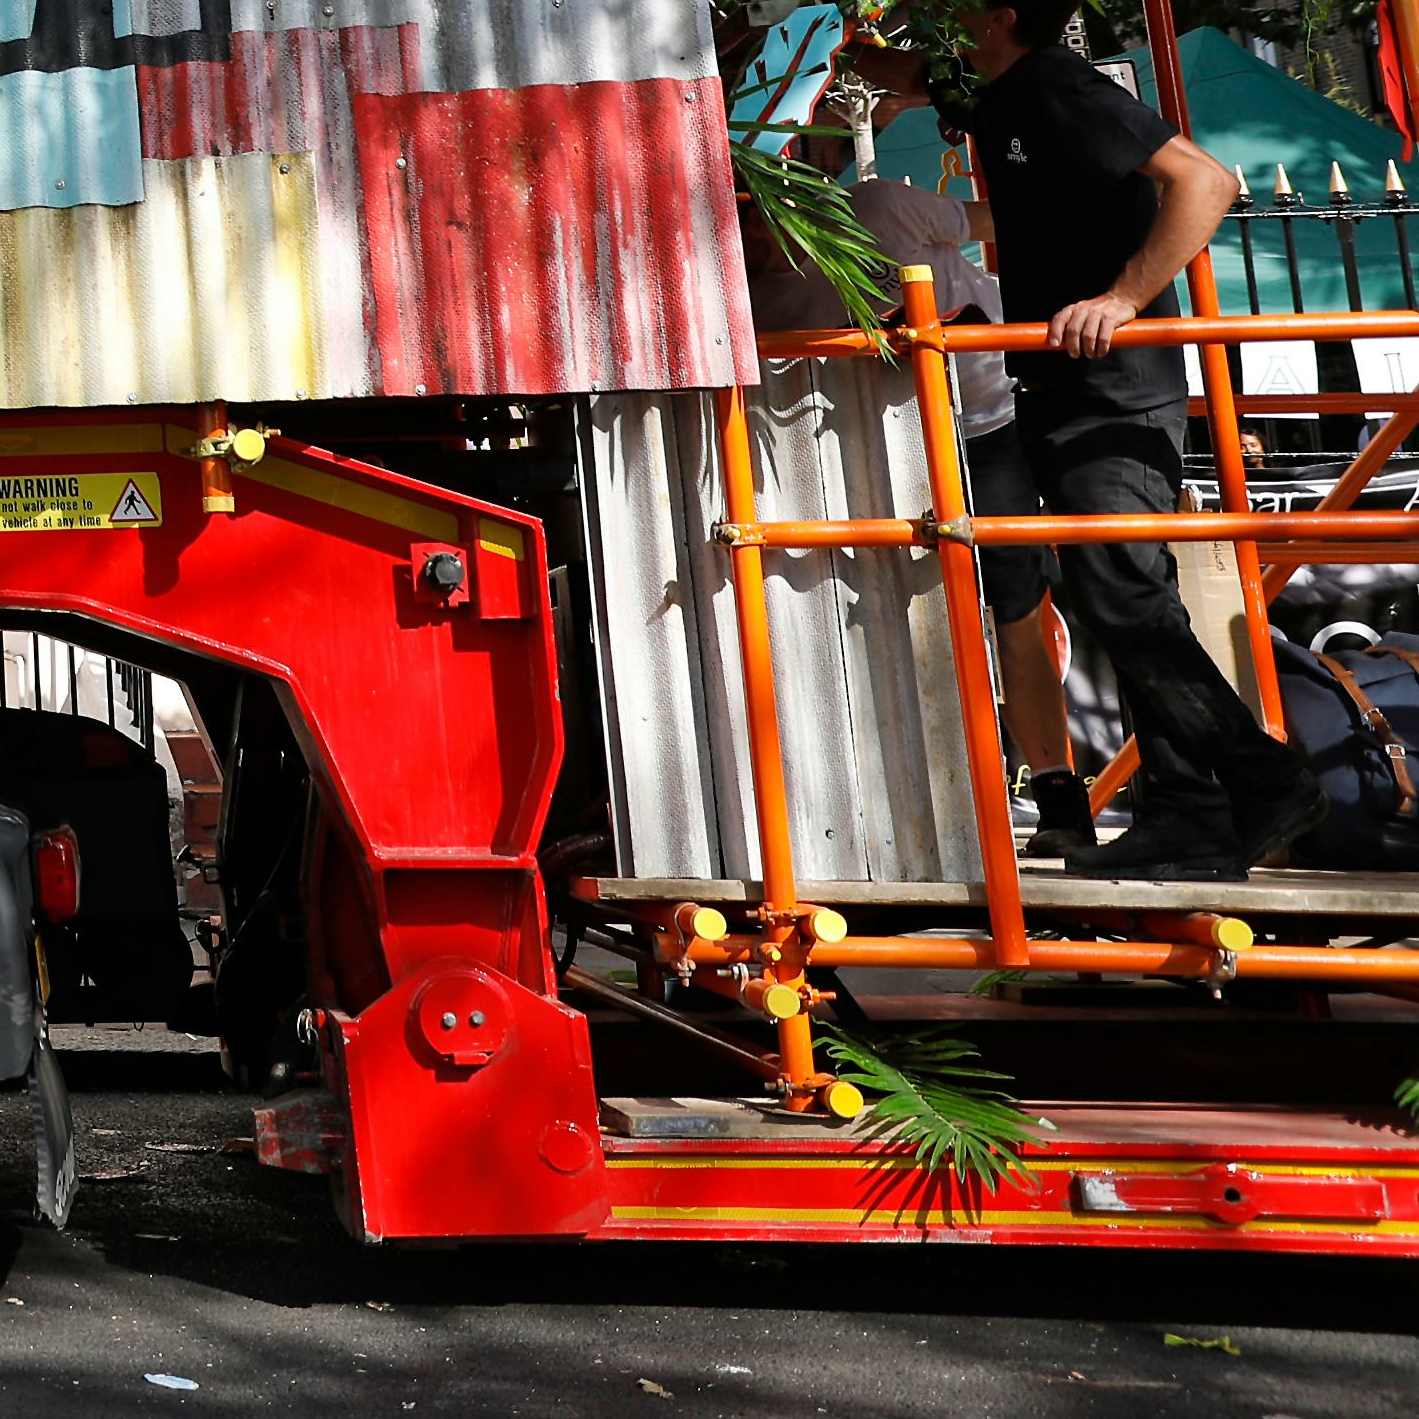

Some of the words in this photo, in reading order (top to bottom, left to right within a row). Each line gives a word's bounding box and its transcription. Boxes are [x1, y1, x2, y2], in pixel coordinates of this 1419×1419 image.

[2, 501, 18, 513] not
[22, 500, 46, 512] walk
[50, 499, 78, 512] close
[82, 499, 93, 510] to
[2, 516, 38, 529] vehicle
[43, 516, 53, 528] at
[57, 516, 74, 530] any
[78, 515, 101, 526] time
